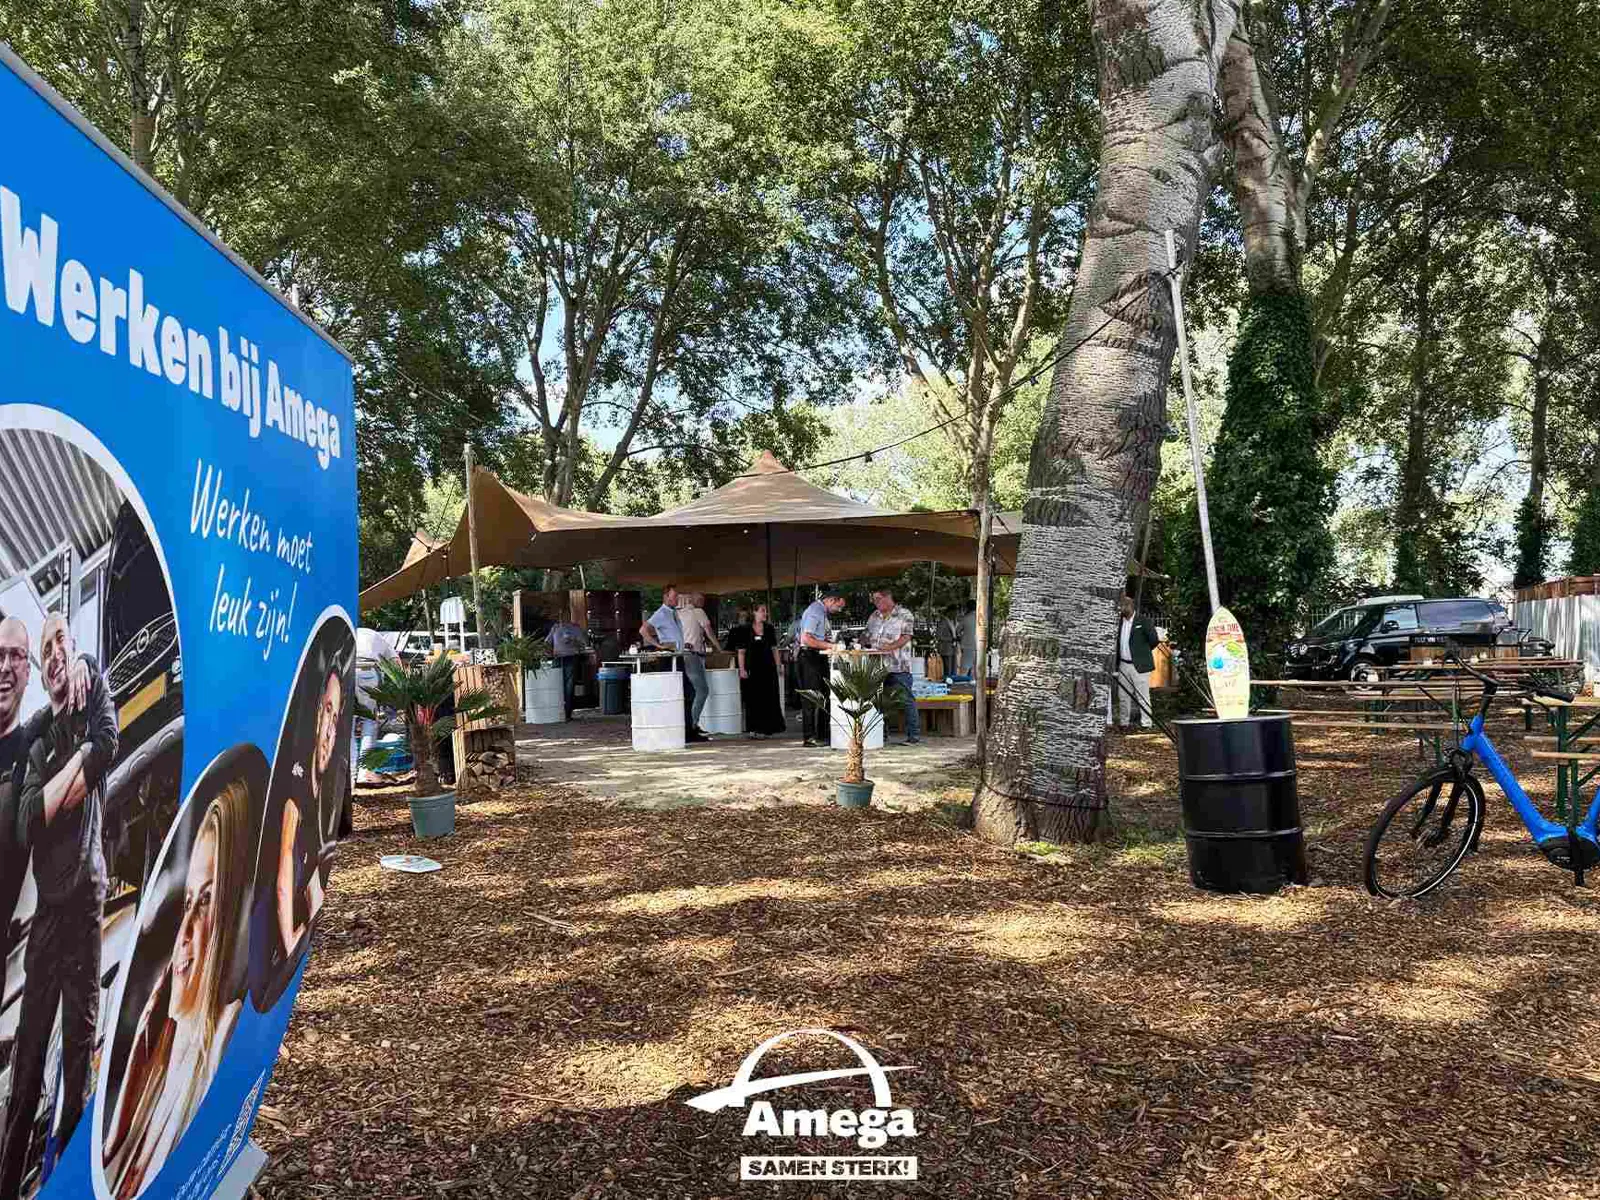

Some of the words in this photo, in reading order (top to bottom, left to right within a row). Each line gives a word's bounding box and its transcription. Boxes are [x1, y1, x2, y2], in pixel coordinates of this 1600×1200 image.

[0, 185, 213, 399] Werken
[219, 326, 260, 439] bij
[265, 360, 341, 470] Amega
[190, 458, 271, 553] Werken
[276, 527, 314, 575] moet
[209, 563, 252, 636] leuk
[255, 581, 298, 660] zijn!
